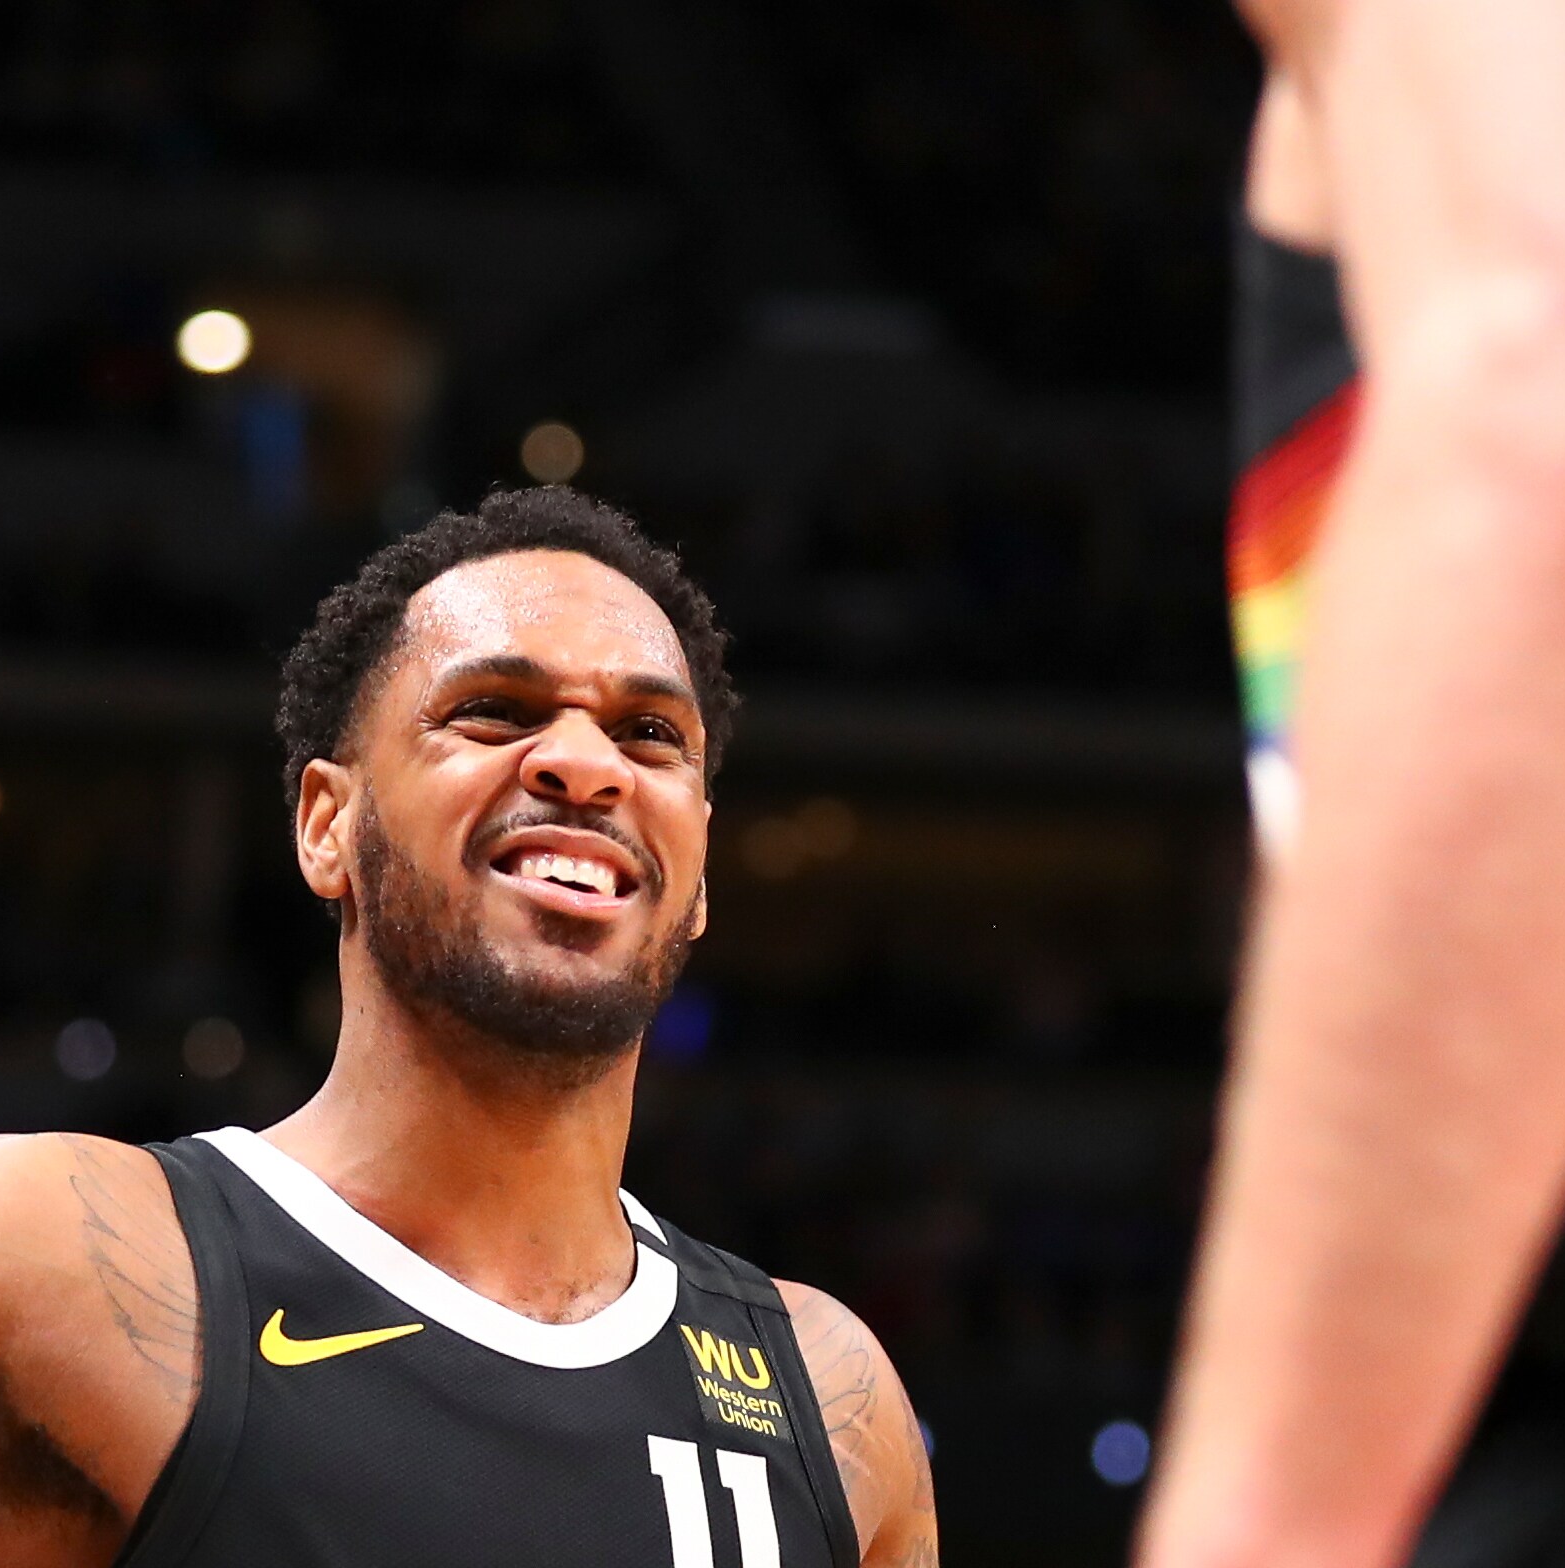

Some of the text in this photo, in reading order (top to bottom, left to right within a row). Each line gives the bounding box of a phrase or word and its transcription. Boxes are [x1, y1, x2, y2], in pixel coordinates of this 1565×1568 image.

[680, 1324, 771, 1390] WU
[697, 1375, 783, 1418] Western
[717, 1401, 777, 1437] Union
